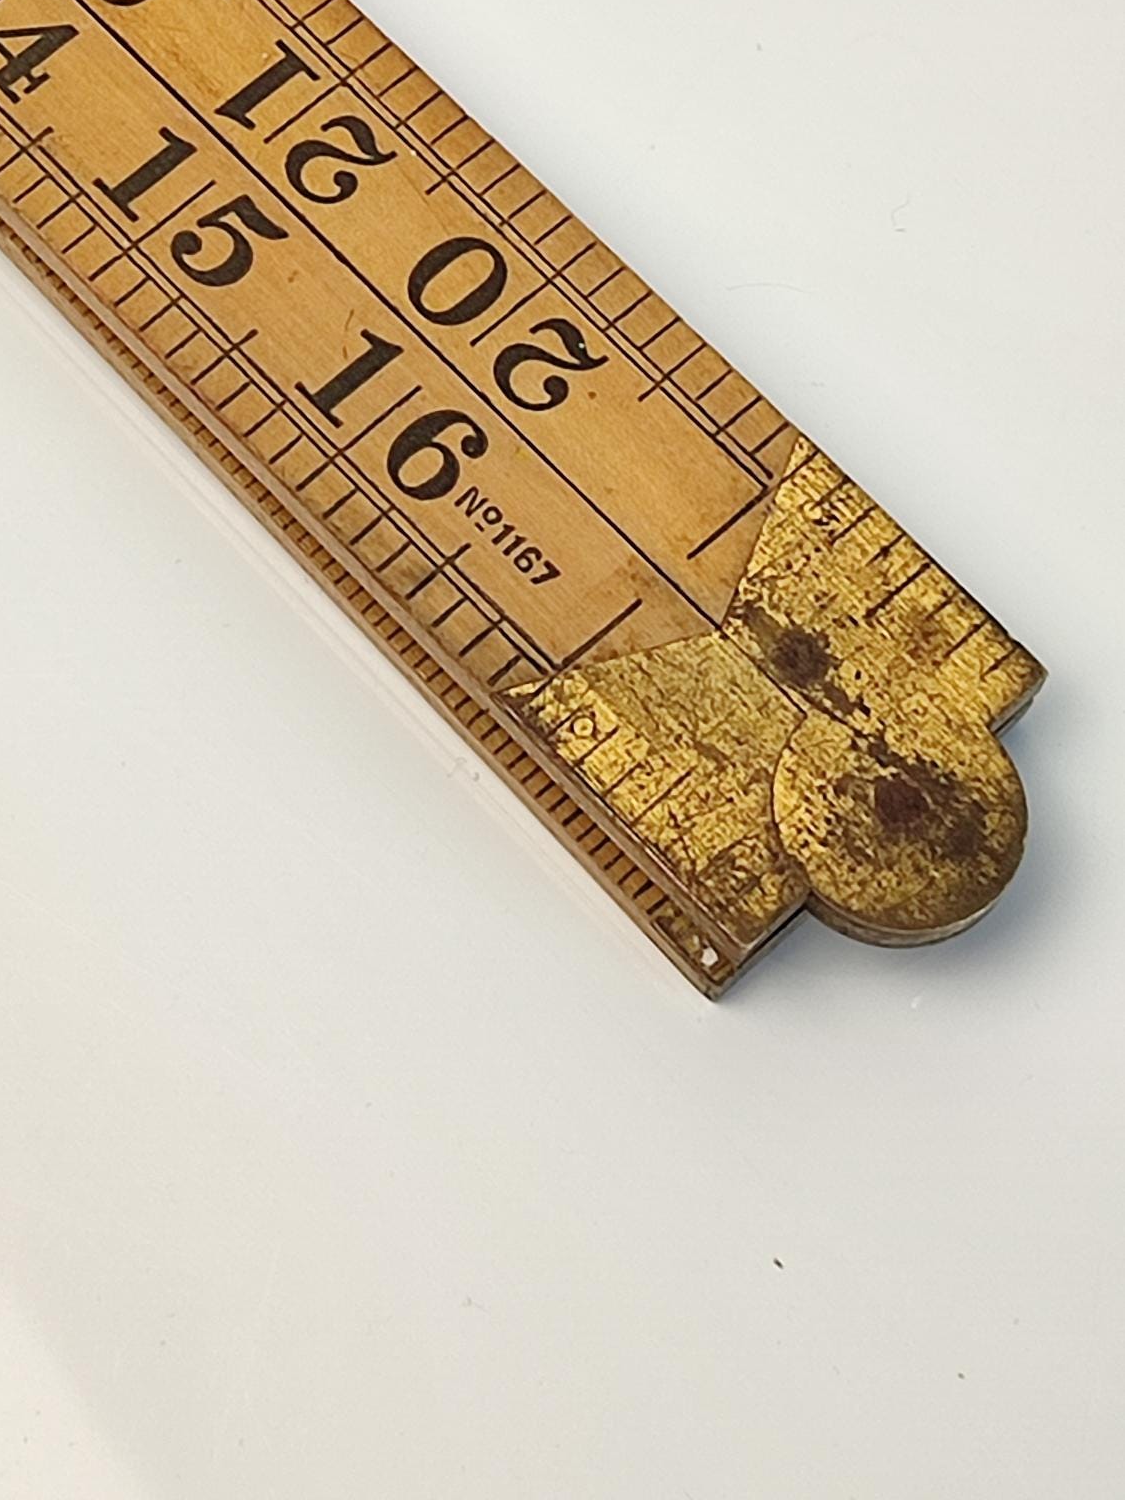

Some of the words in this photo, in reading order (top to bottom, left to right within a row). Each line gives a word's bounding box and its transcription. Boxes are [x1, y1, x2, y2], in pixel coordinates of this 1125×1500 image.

[214, 39, 398, 204] 21
[93, 126, 289, 287] 15
[406, 236, 610, 412] 20
[294, 328, 489, 501] 16
